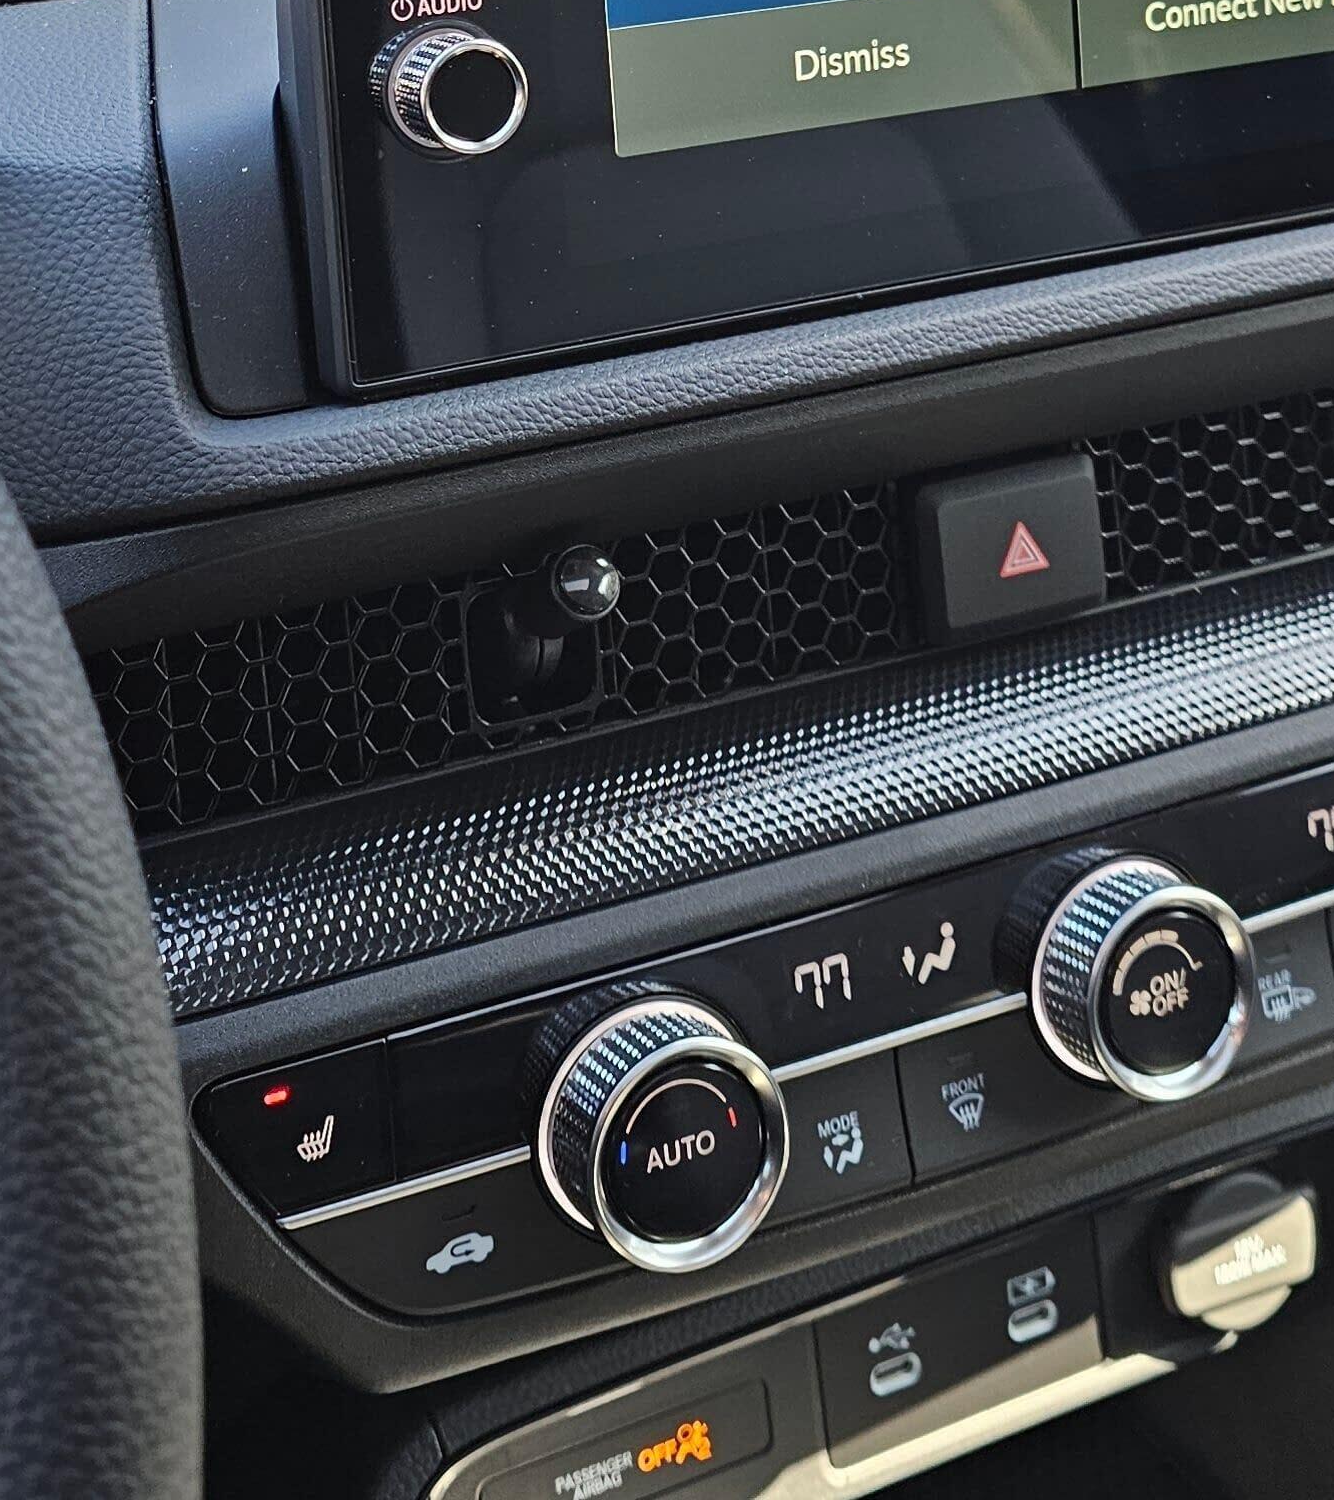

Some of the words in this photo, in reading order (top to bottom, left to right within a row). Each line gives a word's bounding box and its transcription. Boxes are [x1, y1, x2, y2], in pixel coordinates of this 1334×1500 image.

[794, 38, 911, 82] Dismiss
[1149, 966, 1188, 996] ON/
[1257, 968, 1292, 990] REAR
[1152, 986, 1189, 1017] OFF
[941, 1072, 986, 1101] FRONT
[817, 1110, 860, 1140] MODE
[646, 1129, 716, 1174] AUTO
[637, 1438, 678, 1473] OFF
[554, 1450, 634, 1495] PASSENGER
[572, 1473, 623, 1500] AIRBAG
